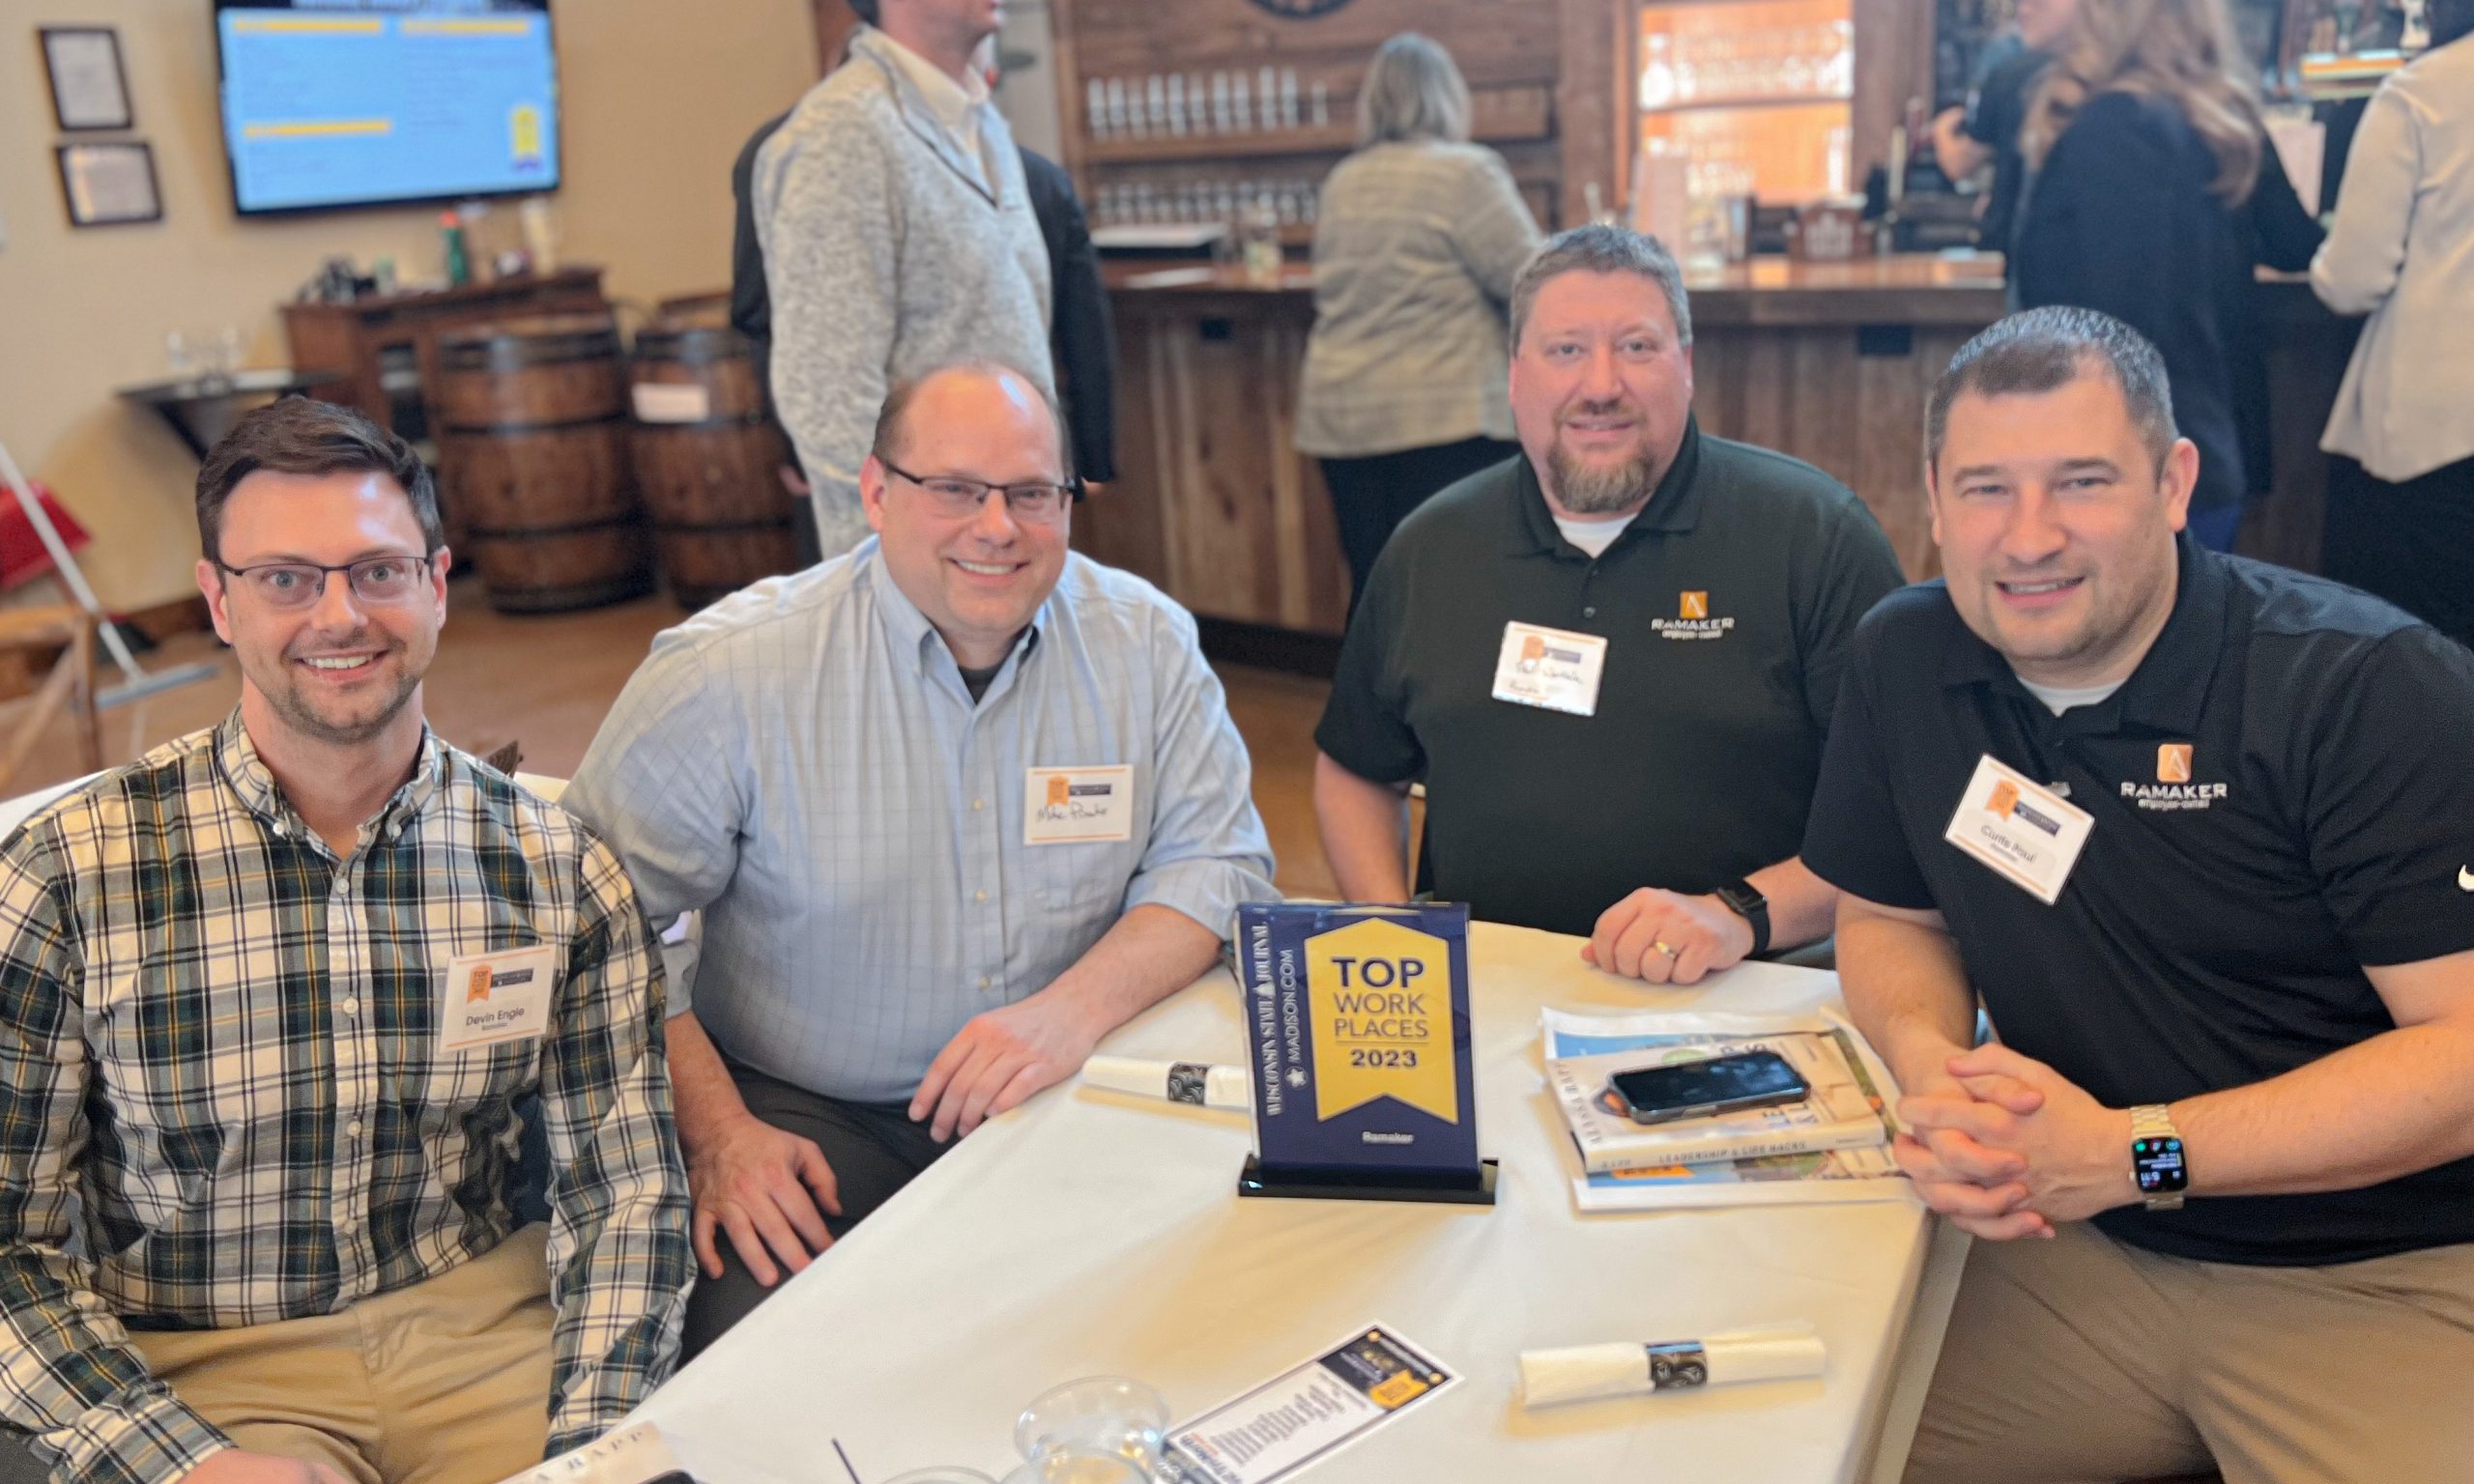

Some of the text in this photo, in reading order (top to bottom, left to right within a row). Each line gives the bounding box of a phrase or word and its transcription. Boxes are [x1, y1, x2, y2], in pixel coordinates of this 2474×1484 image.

[1651, 616, 1735, 631] RAMAKER
[2120, 782, 2228, 799] RAMAKER
[1331, 957, 1425, 987] TOP
[1280, 949, 1301, 1063] MADISON.COM
[1333, 992, 1427, 1014] WORK
[465, 1012, 495, 1025] Devin
[1334, 1017, 1429, 1039] PLACES
[1350, 1048, 1418, 1068] 2023
[1261, 1039, 1283, 1116] WISCONSIN
